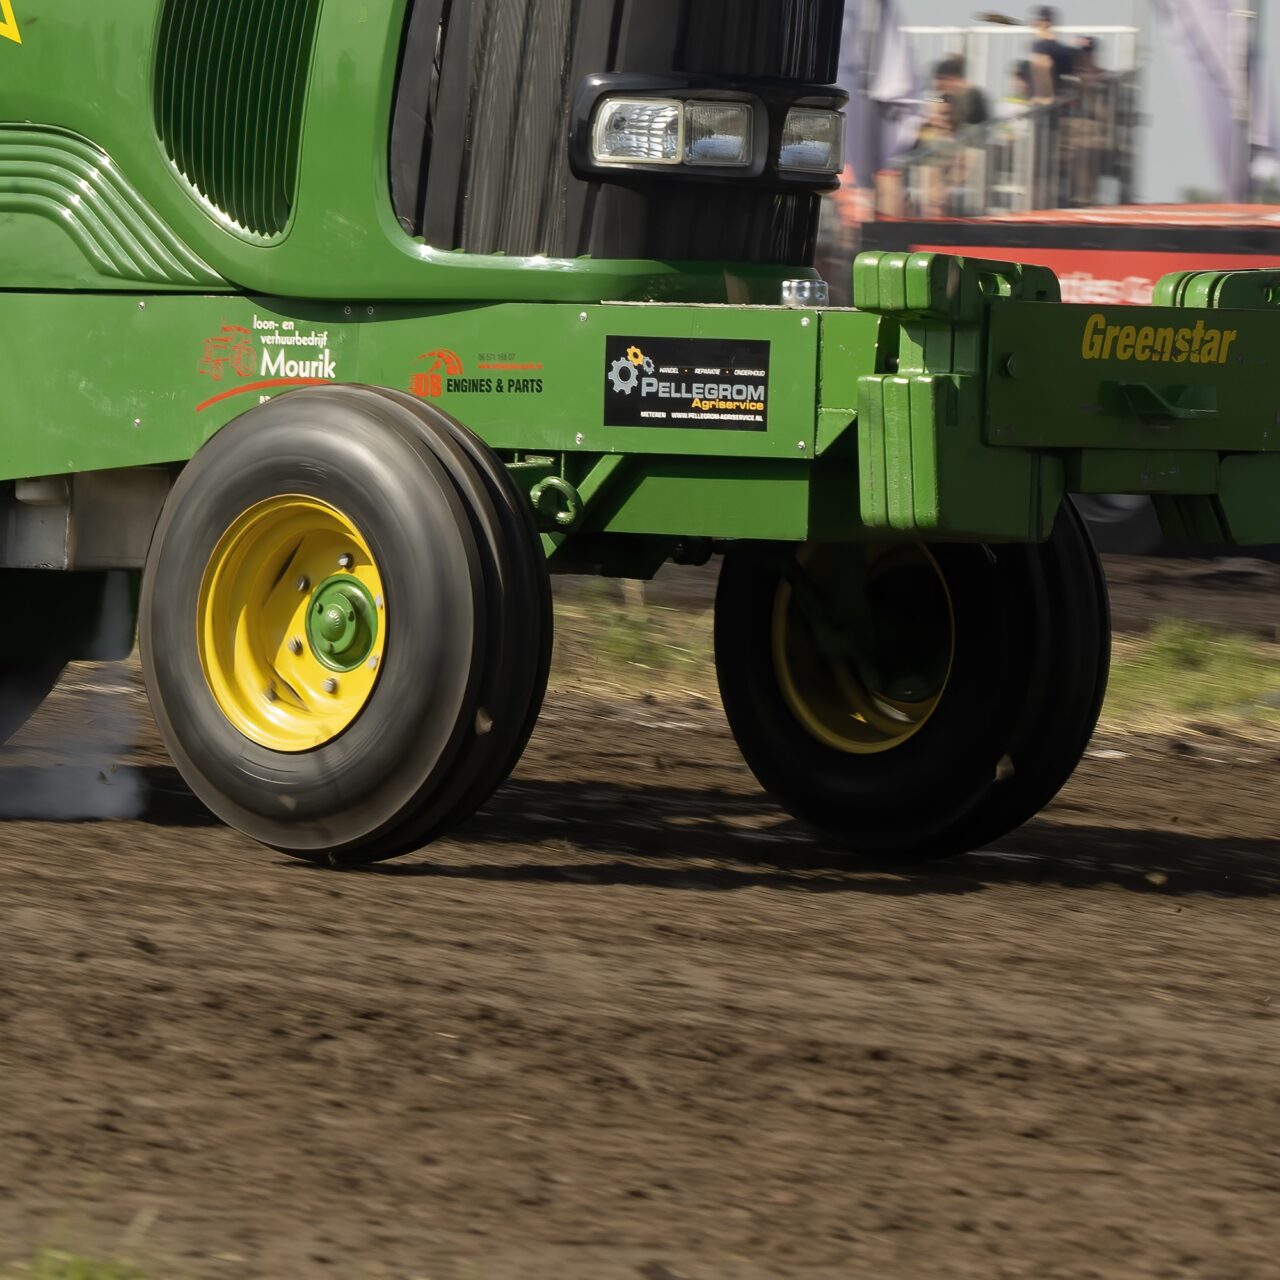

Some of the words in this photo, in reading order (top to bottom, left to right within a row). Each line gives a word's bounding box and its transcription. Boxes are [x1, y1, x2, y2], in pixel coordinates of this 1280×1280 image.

[253, 314, 279, 330] loon-
[282, 320, 294, 330] en
[261, 330, 328, 348] verhuurbedrijf
[1081, 313, 1237, 364] Greenstar
[260, 348, 336, 379] Mourik
[447, 378, 492, 393] ENGINES
[496, 378, 504, 393] &
[508, 378, 543, 393] PARTS
[641, 377, 765, 401] PELLEGROM
[691, 398, 764, 411] Agriservice
